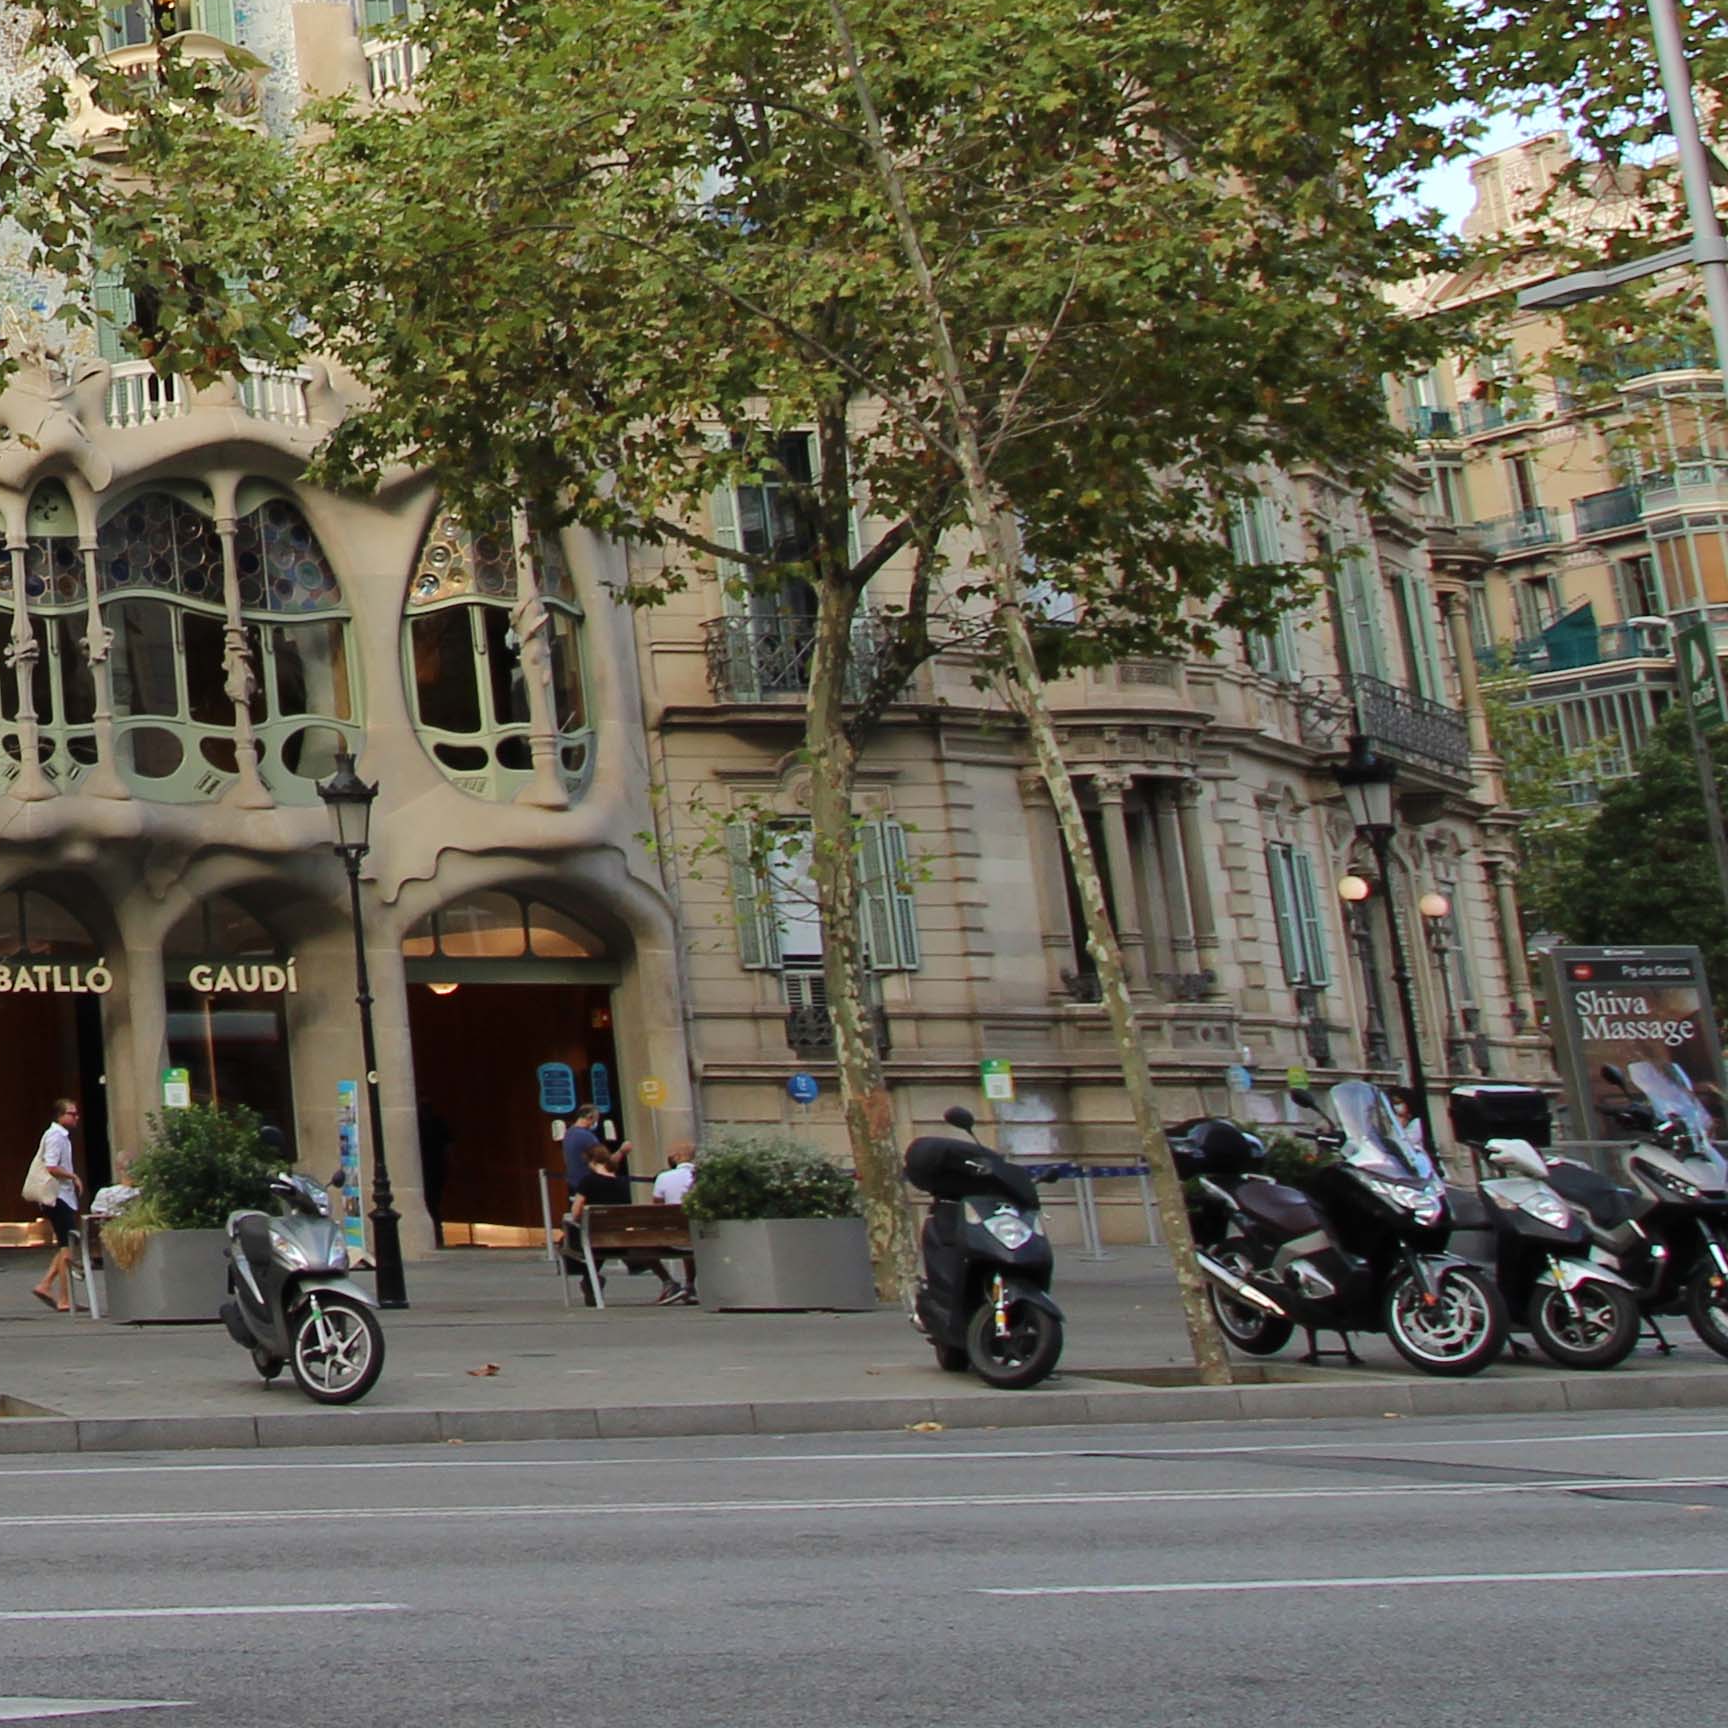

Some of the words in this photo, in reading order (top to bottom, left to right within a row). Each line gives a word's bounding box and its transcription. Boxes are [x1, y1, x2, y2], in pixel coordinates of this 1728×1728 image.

[188, 956, 298, 993] GAUDÍ
[1575, 990, 1650, 1016] Shiva
[1580, 1016, 1695, 1046] Massage
